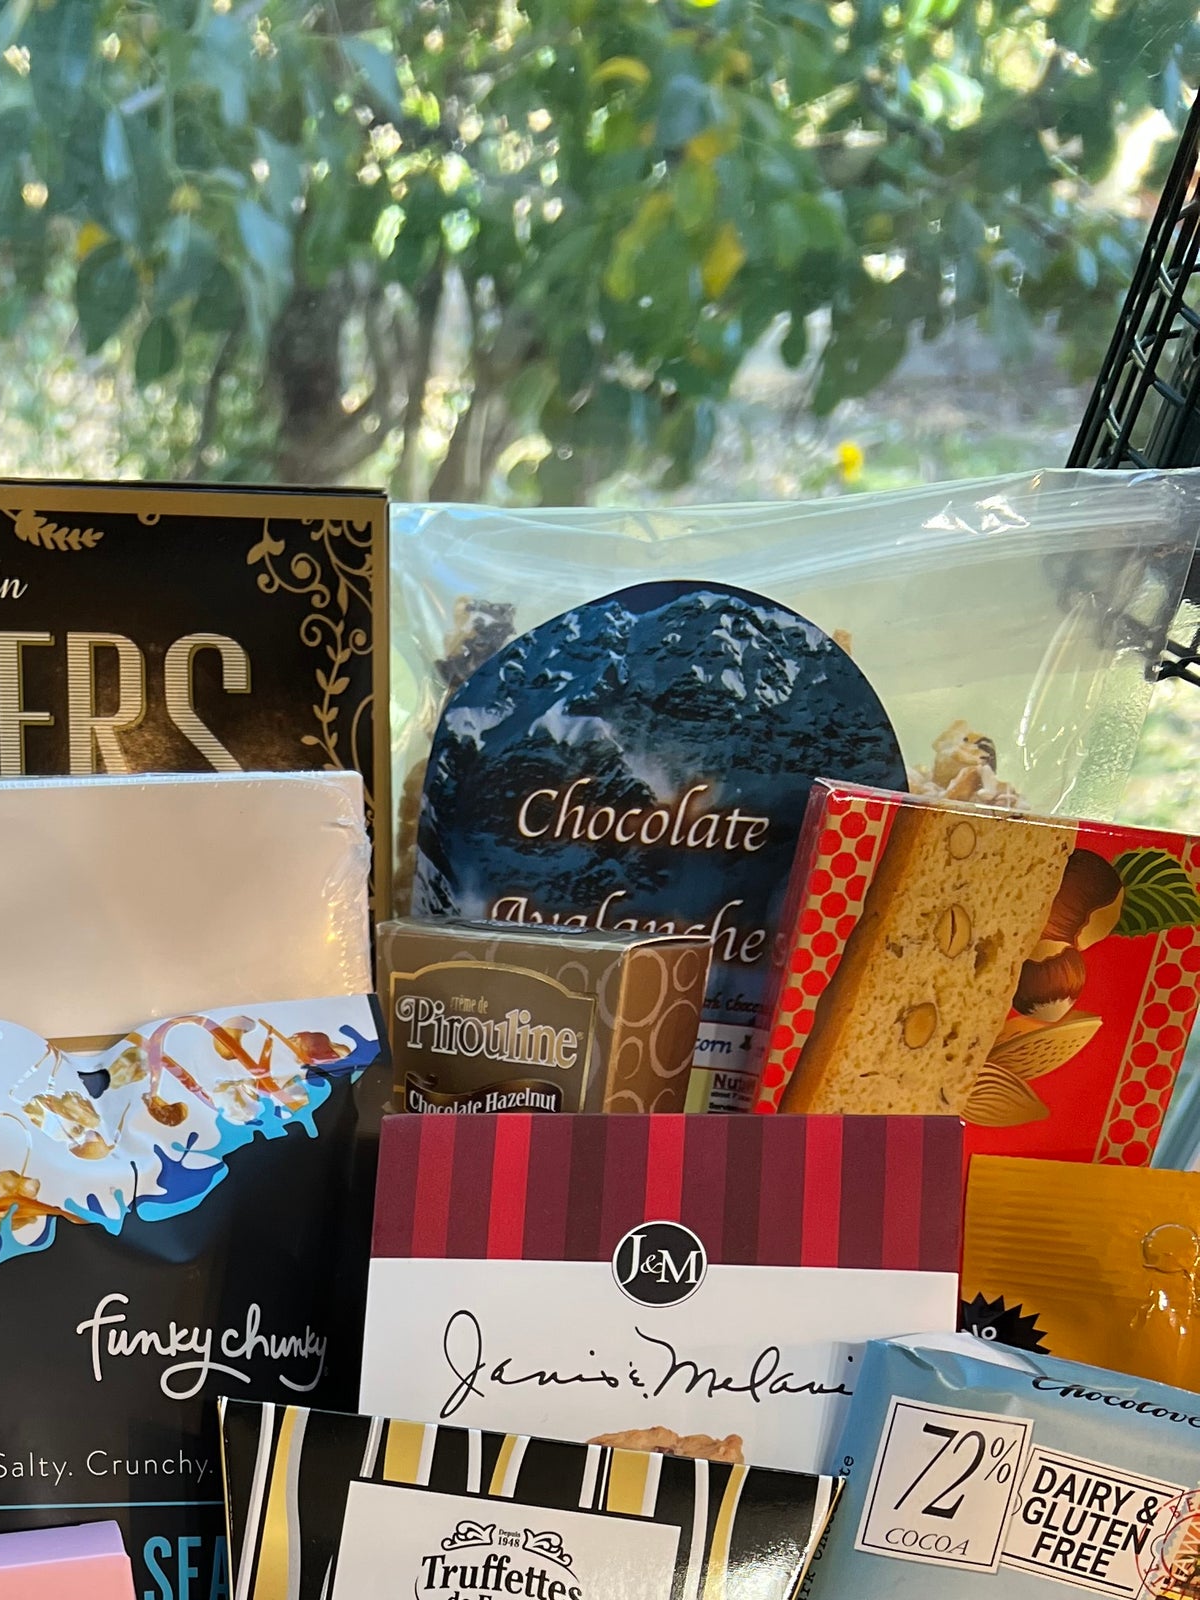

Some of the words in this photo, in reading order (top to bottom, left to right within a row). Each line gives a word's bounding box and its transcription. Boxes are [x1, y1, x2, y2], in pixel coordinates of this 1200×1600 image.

[517, 777, 770, 851] Chocolate
[395, 994, 579, 1071] Pirouline
[620, 1235, 699, 1285] J&M
[77, 1293, 250, 1400] funky
[221, 1304, 328, 1391] chunky
[89, 1450, 214, 1479] Crunchy.
[893, 1423, 1017, 1519] 72%
[1032, 1465, 1136, 1516] DAIRY
[1135, 1496, 1159, 1527] &
[498, 1528, 521, 1539] Depuis
[498, 1536, 520, 1548] 1948
[885, 1527, 970, 1557] COCOA
[1022, 1496, 1152, 1555] GLUTEN
[1031, 1532, 1116, 1578] FREE
